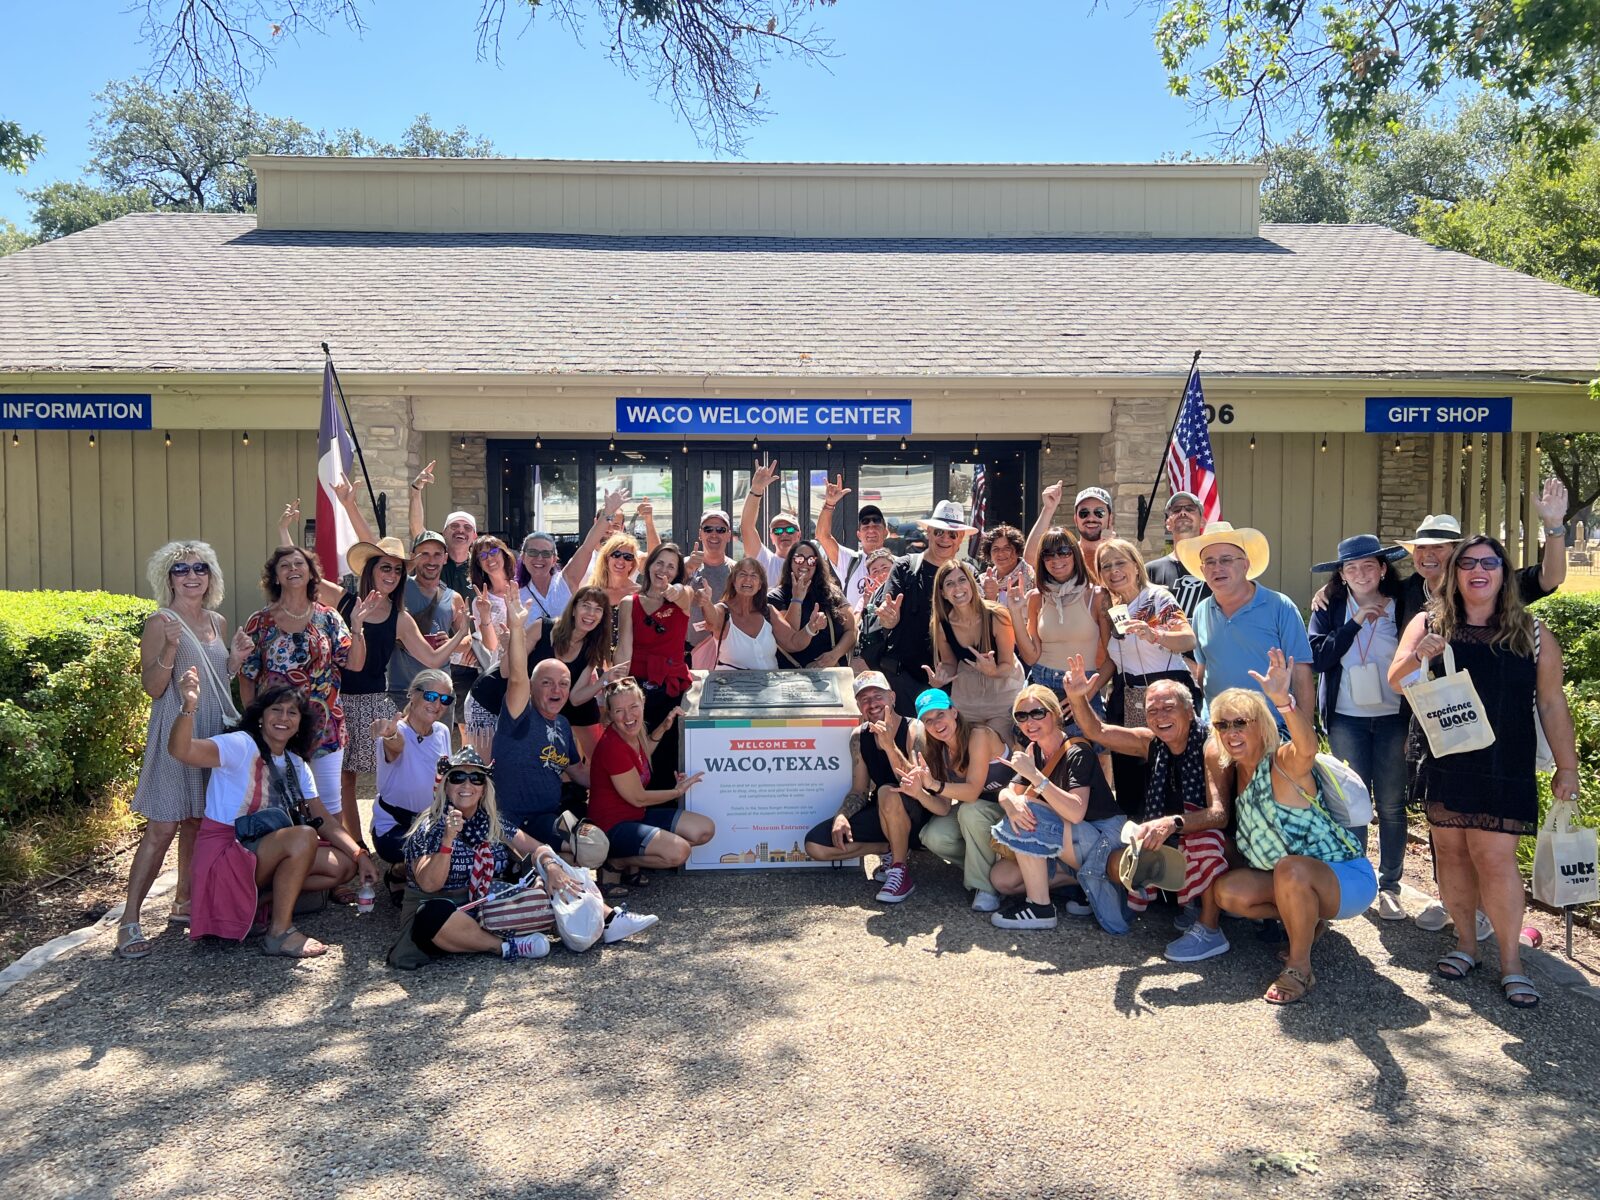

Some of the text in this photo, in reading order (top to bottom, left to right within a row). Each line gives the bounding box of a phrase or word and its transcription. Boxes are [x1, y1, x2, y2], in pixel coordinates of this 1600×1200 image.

[2, 403, 143, 419] INFORMATION
[626, 406, 902, 424] WACO WELCOME CENTER
[1388, 407, 1490, 423] GIFT SHOP
[1426, 701, 1472, 719] experience
[1440, 710, 1478, 730] waco
[736, 741, 788, 749] WELCOME
[1560, 861, 1595, 876] wtx
